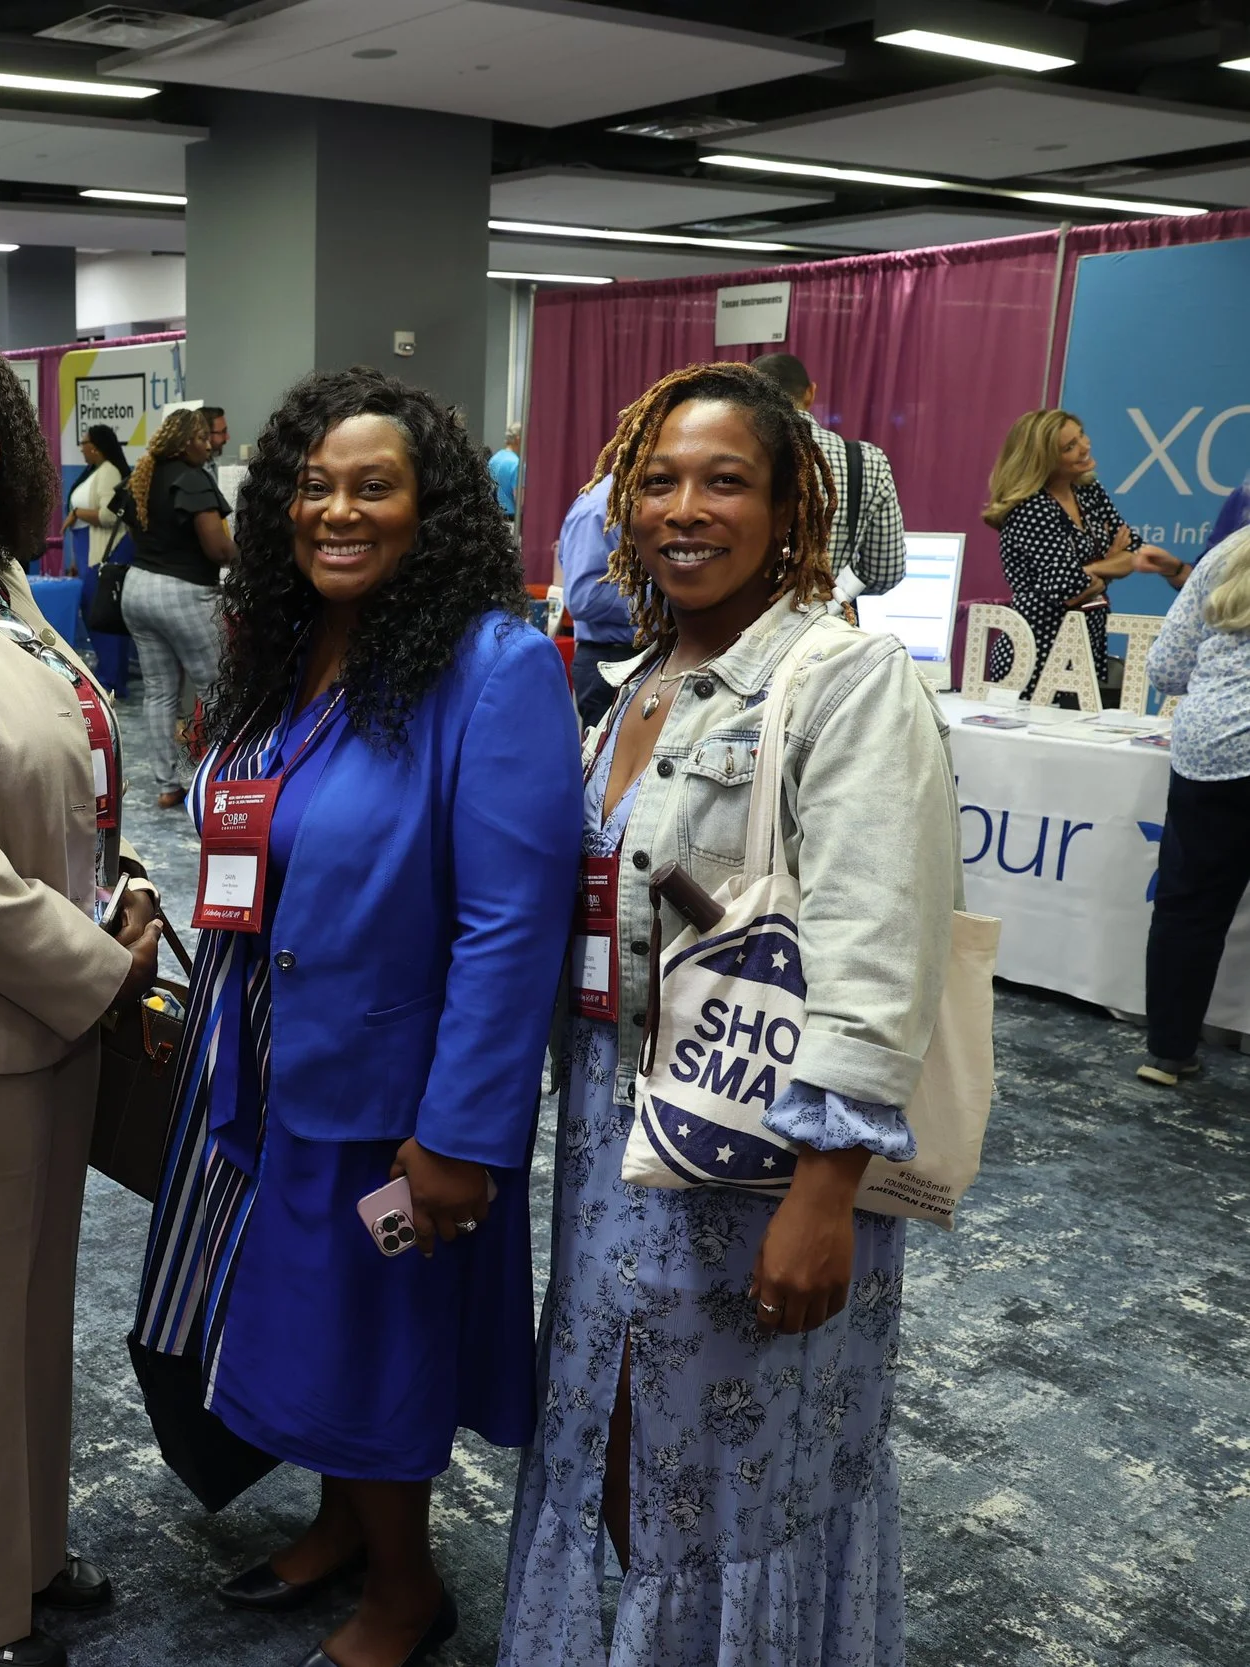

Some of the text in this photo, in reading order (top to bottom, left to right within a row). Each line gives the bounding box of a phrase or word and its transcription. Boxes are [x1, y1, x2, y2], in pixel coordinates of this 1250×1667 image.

[79, 385, 100, 402] The
[79, 403, 134, 420] Princeton
[961, 603, 1178, 718] DAT
[694, 998, 801, 1065] SHO
[669, 1038, 776, 1111] SMA
[883, 1178, 956, 1207] FOUNDING PARTNER
[898, 1170, 951, 1194] #ShopSmall
[866, 1185, 919, 1206] AMERICAN
